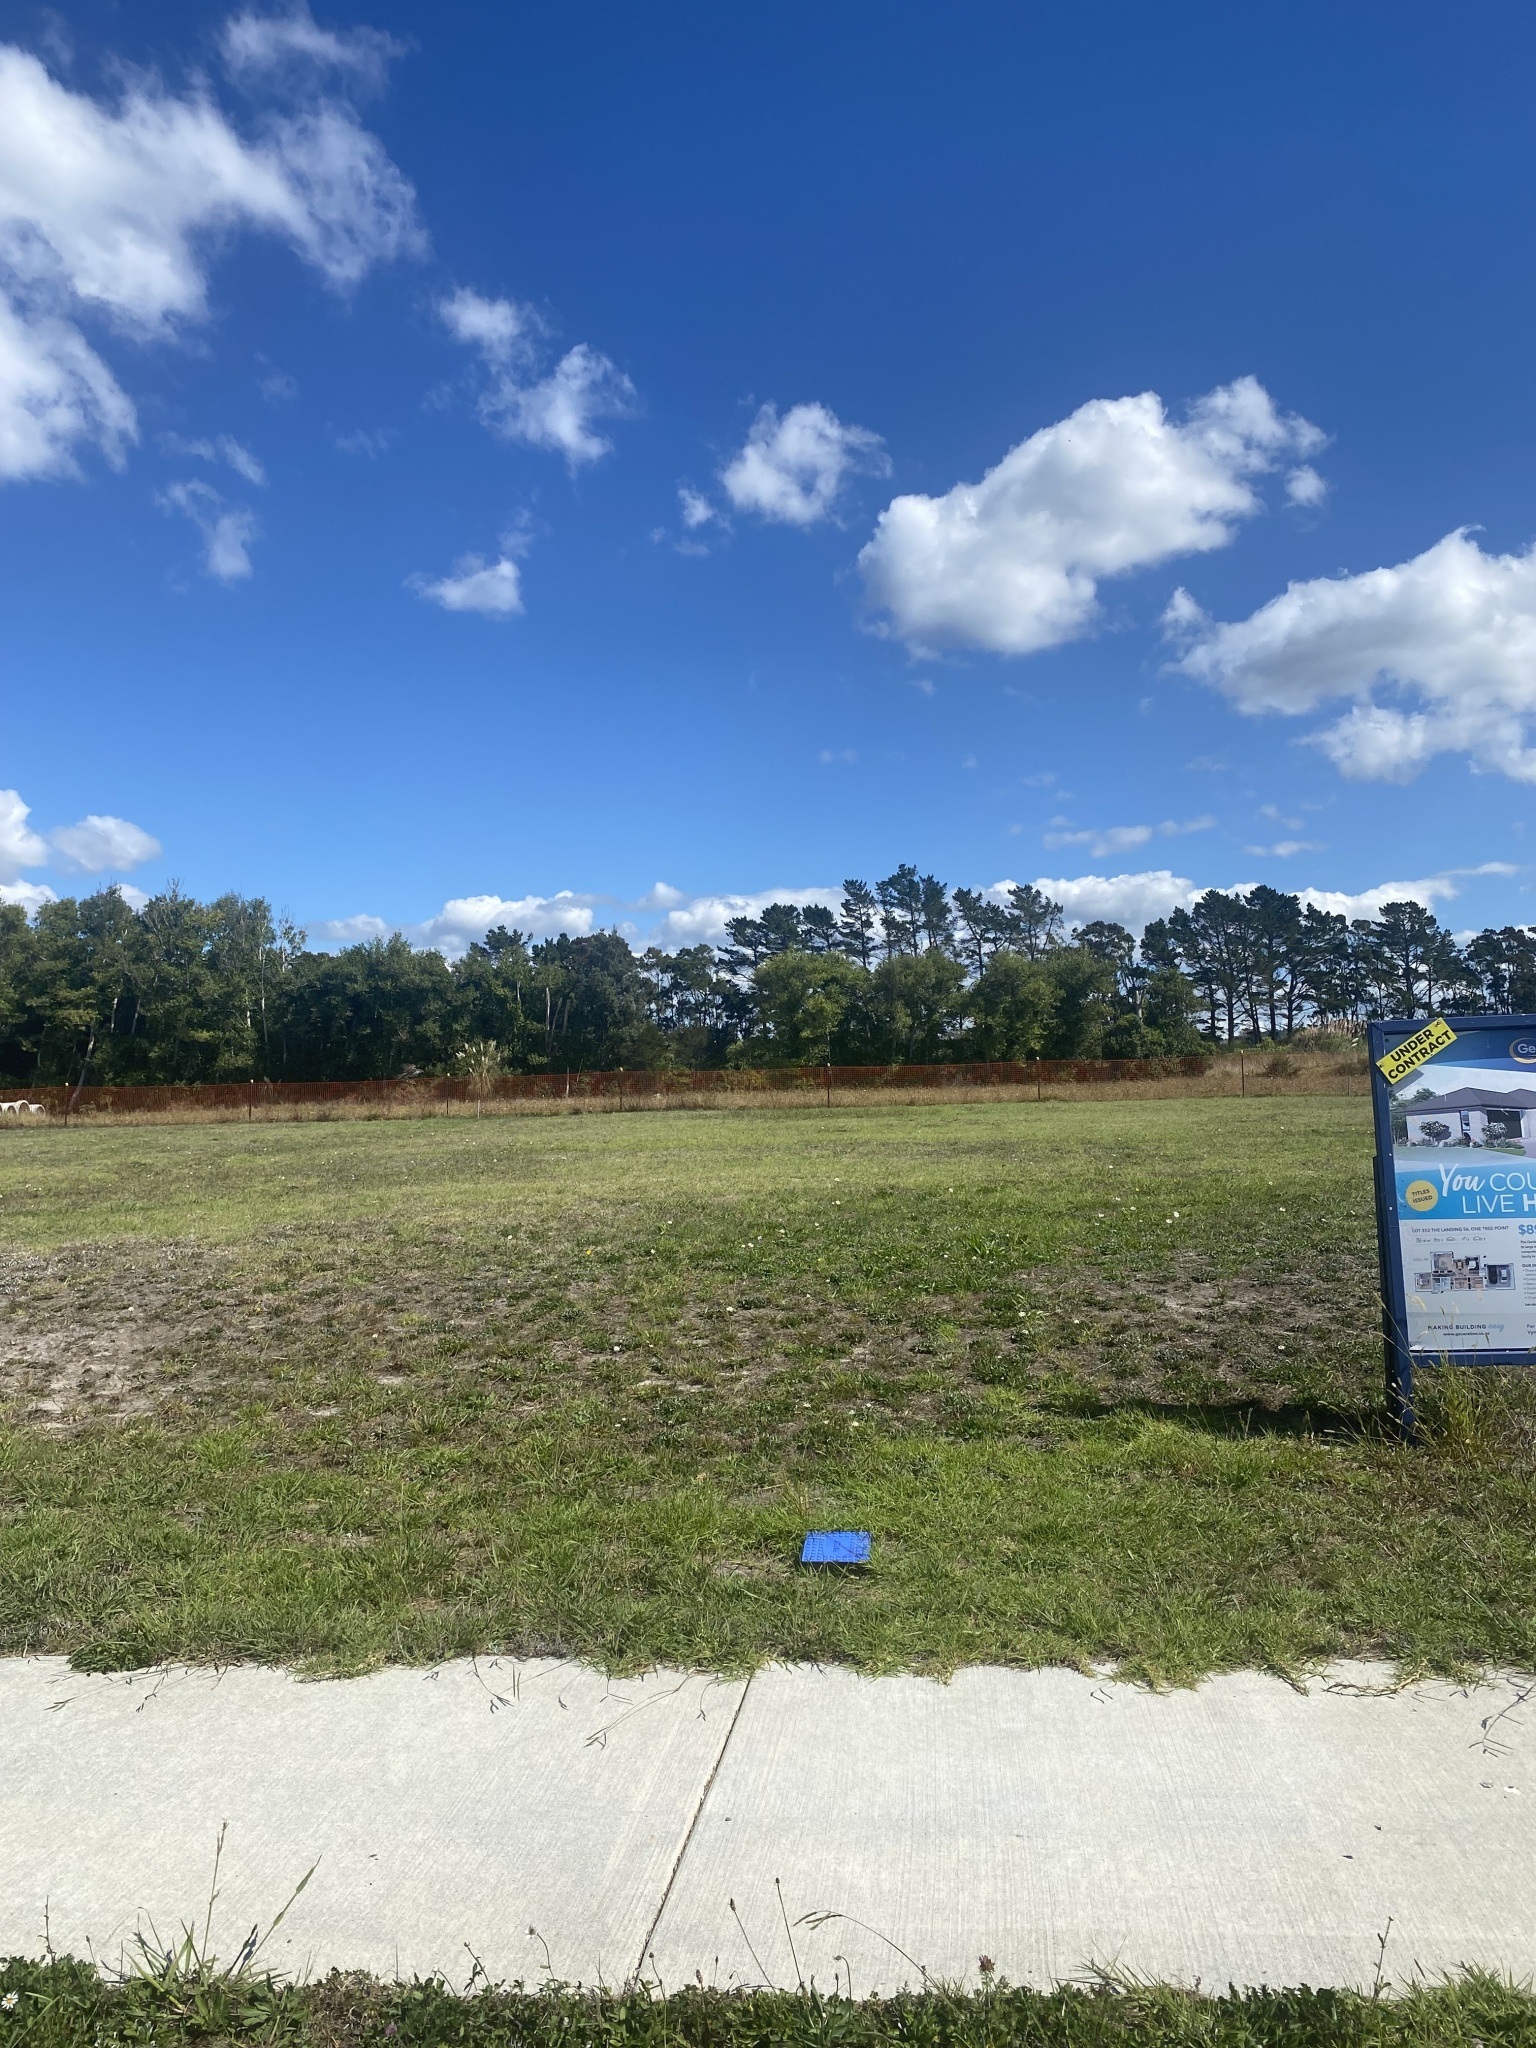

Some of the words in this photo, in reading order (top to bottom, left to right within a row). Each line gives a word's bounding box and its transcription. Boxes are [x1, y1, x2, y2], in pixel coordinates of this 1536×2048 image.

[1388, 1030, 1451, 1079] CONTRACT
[1390, 1029, 1434, 1062] UNDER
[1439, 1163, 1485, 1197] You
[1412, 1195, 1433, 1203] ISSUED
[1462, 1194, 1515, 1213] LIVE
[1488, 1323, 1504, 1332] easy
